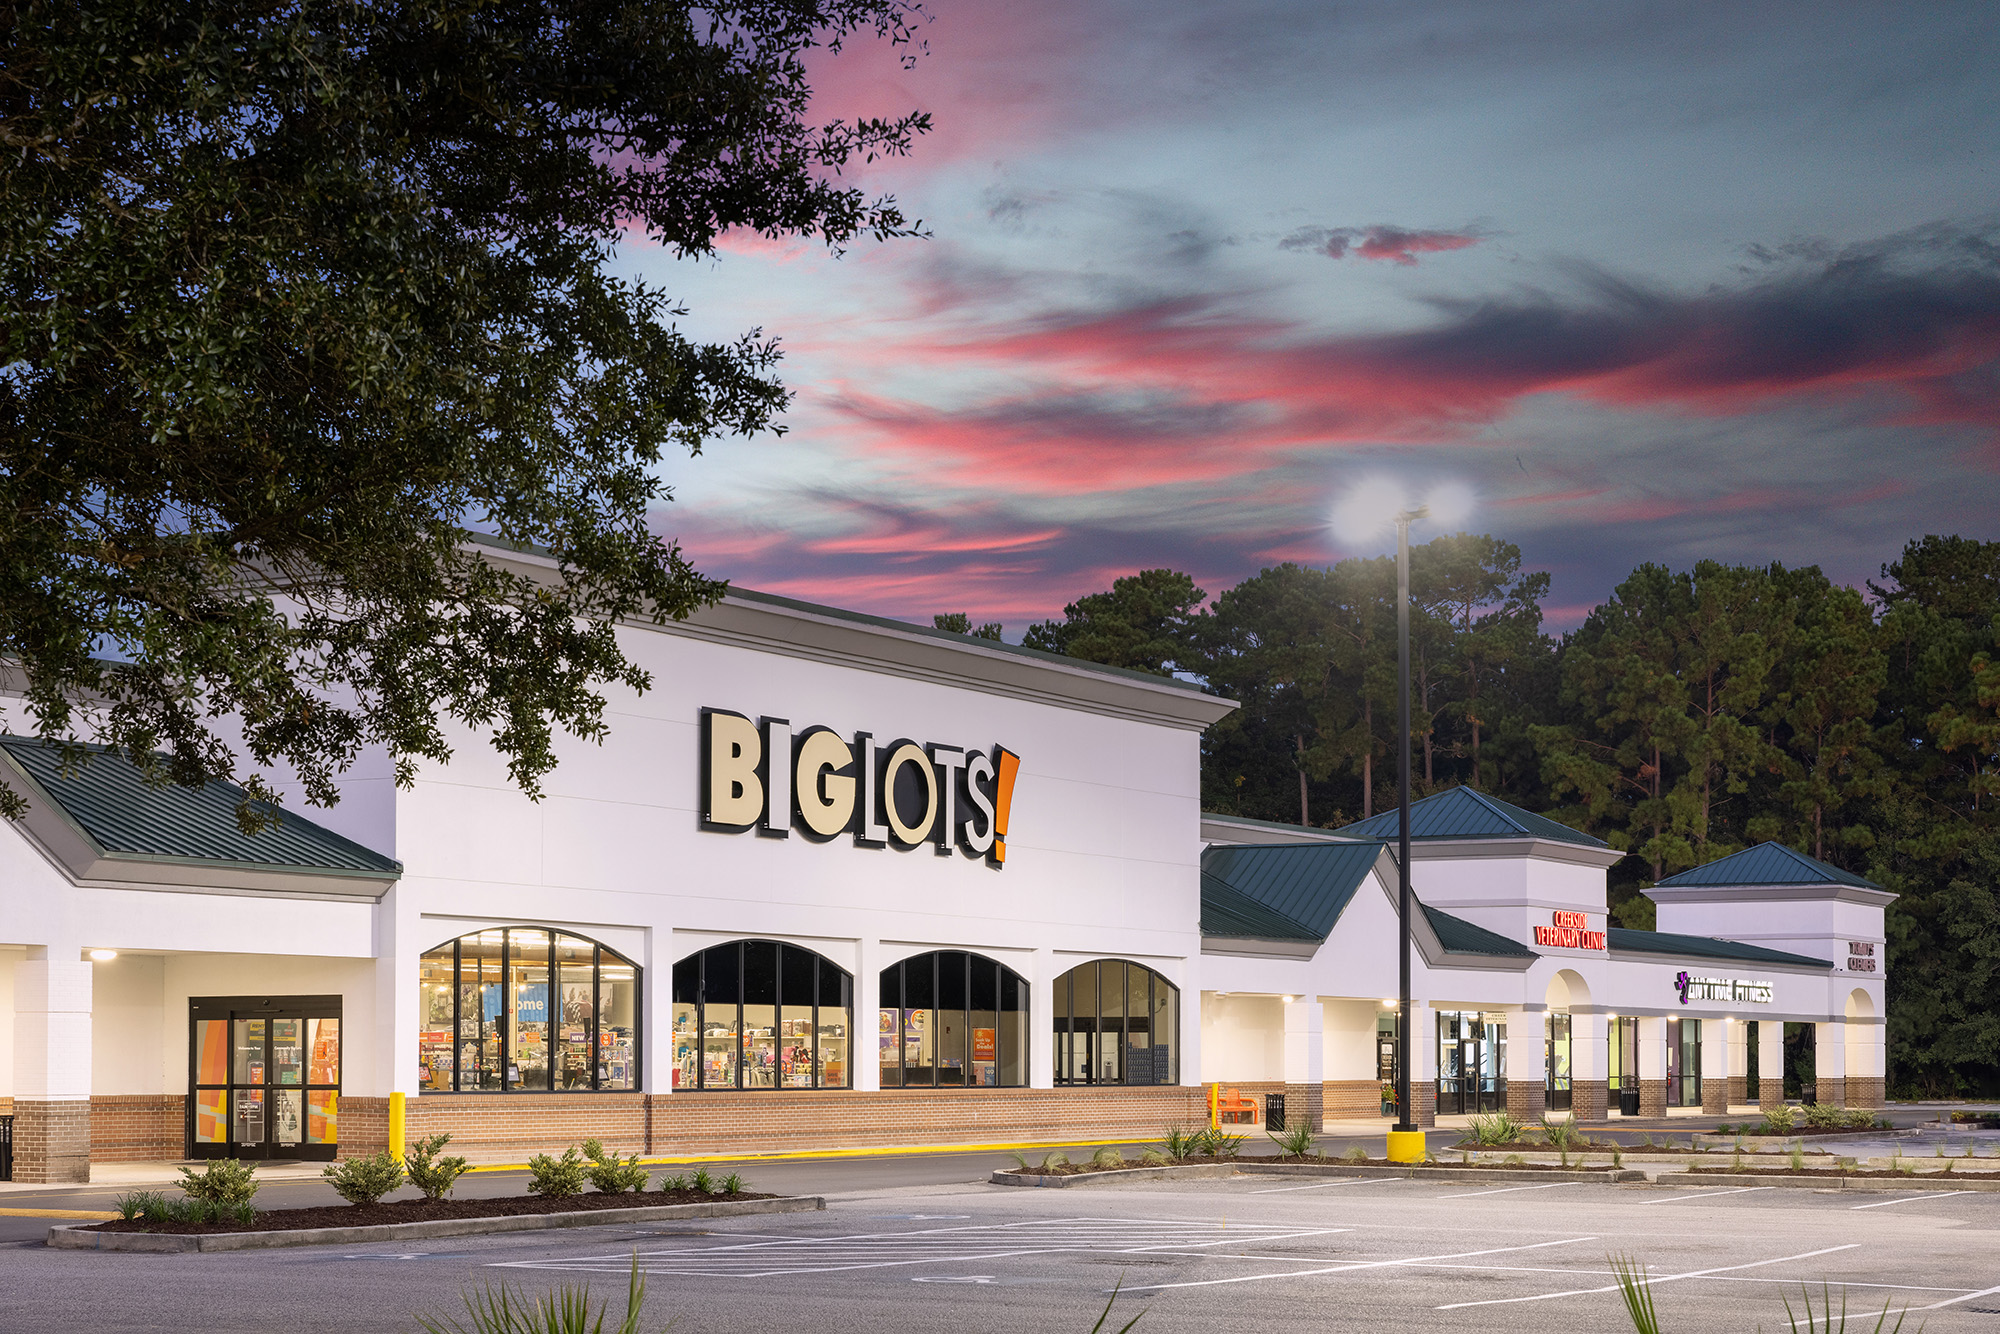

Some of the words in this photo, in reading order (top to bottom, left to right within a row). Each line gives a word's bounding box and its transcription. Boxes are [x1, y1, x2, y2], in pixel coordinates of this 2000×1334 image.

[703, 707, 856, 841] BIG
[1554, 911, 1588, 929] CREEKSIDE
[1535, 926, 1580, 947] VETERINARY
[1581, 930, 1605, 950] CLINIC
[1687, 977, 1732, 1001] ANYTIME
[1733, 979, 1774, 1003] FITNESS
[517, 1000, 544, 1011] ome
